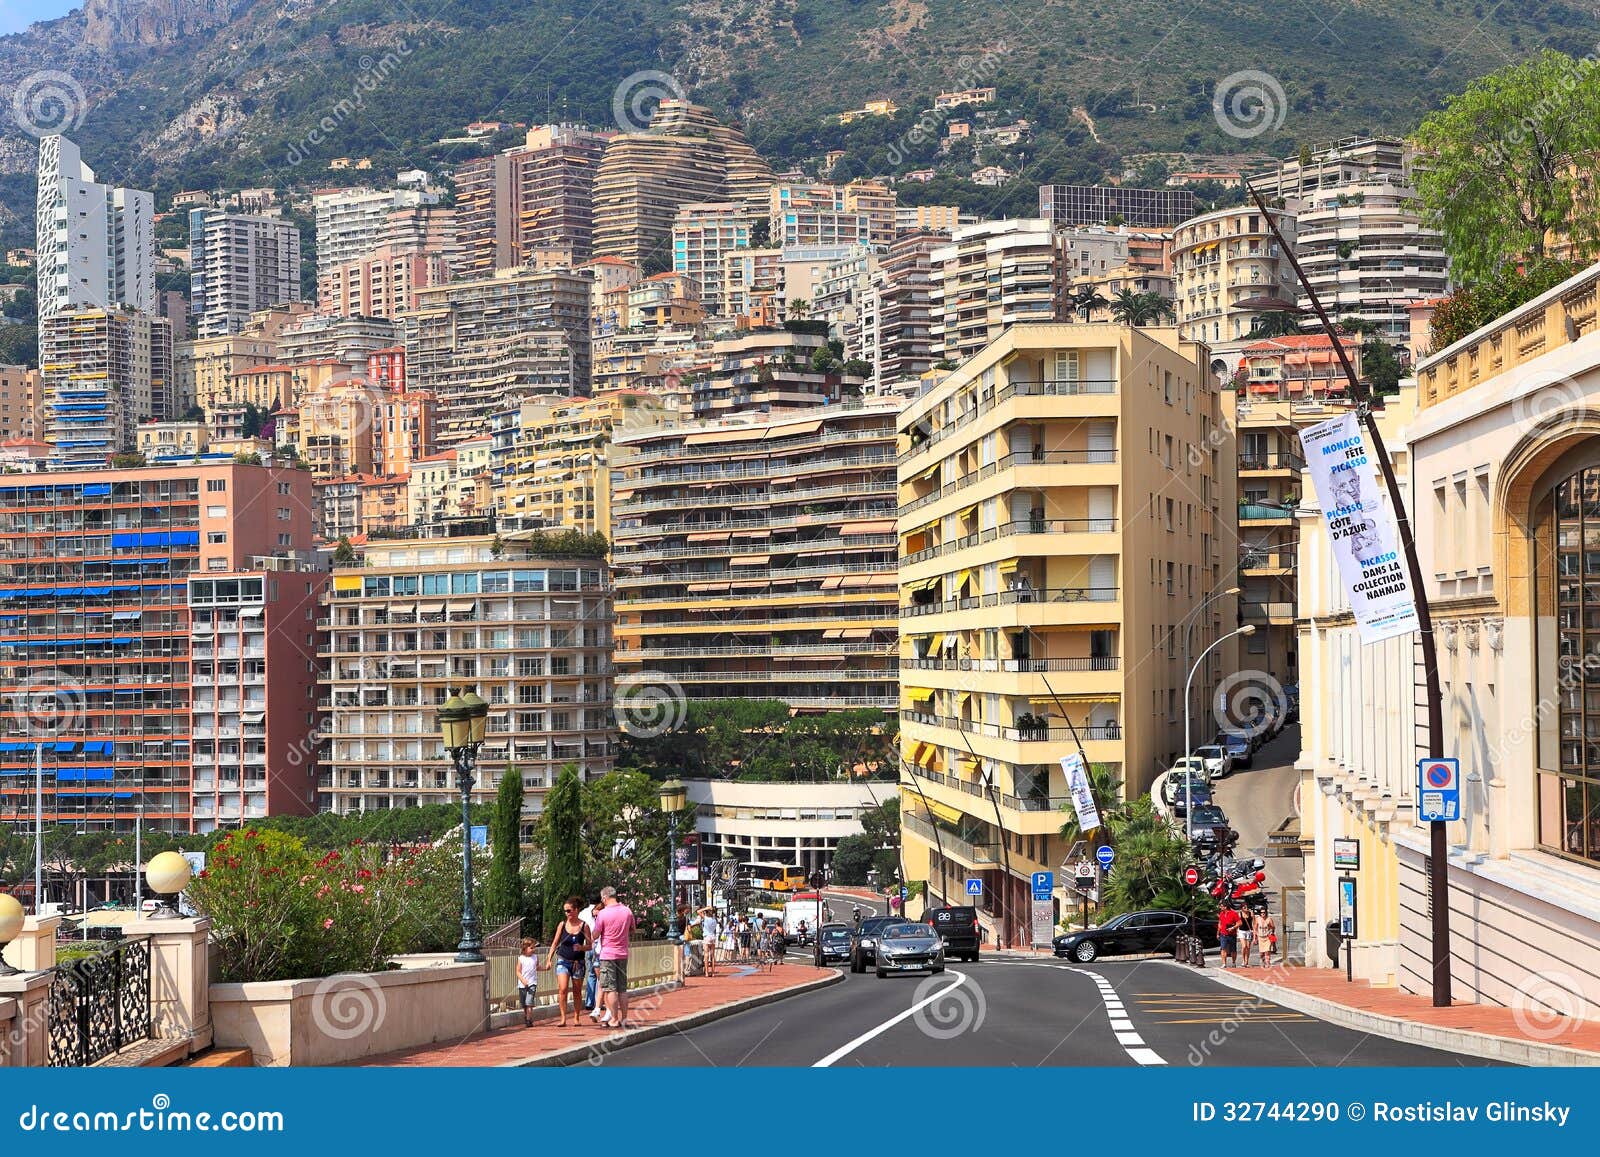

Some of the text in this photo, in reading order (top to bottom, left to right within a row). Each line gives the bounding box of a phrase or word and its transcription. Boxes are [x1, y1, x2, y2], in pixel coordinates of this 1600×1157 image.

[1322, 436, 1360, 455] MONACO
[1345, 446, 1365, 459] FÊTE
[1331, 456, 1367, 474] PICASSO
[1327, 503, 1363, 520] PICASSO
[1330, 516, 1352, 530] CÔTE
[1333, 523, 1368, 540] D'AZUR
[1360, 551, 1396, 568] PICASSO
[1363, 562, 1400, 579] DANS LA
[1353, 571, 1404, 592] COLLECTION
[1366, 582, 1406, 600] NAHMAD
[1037, 874, 1046, 886] P
